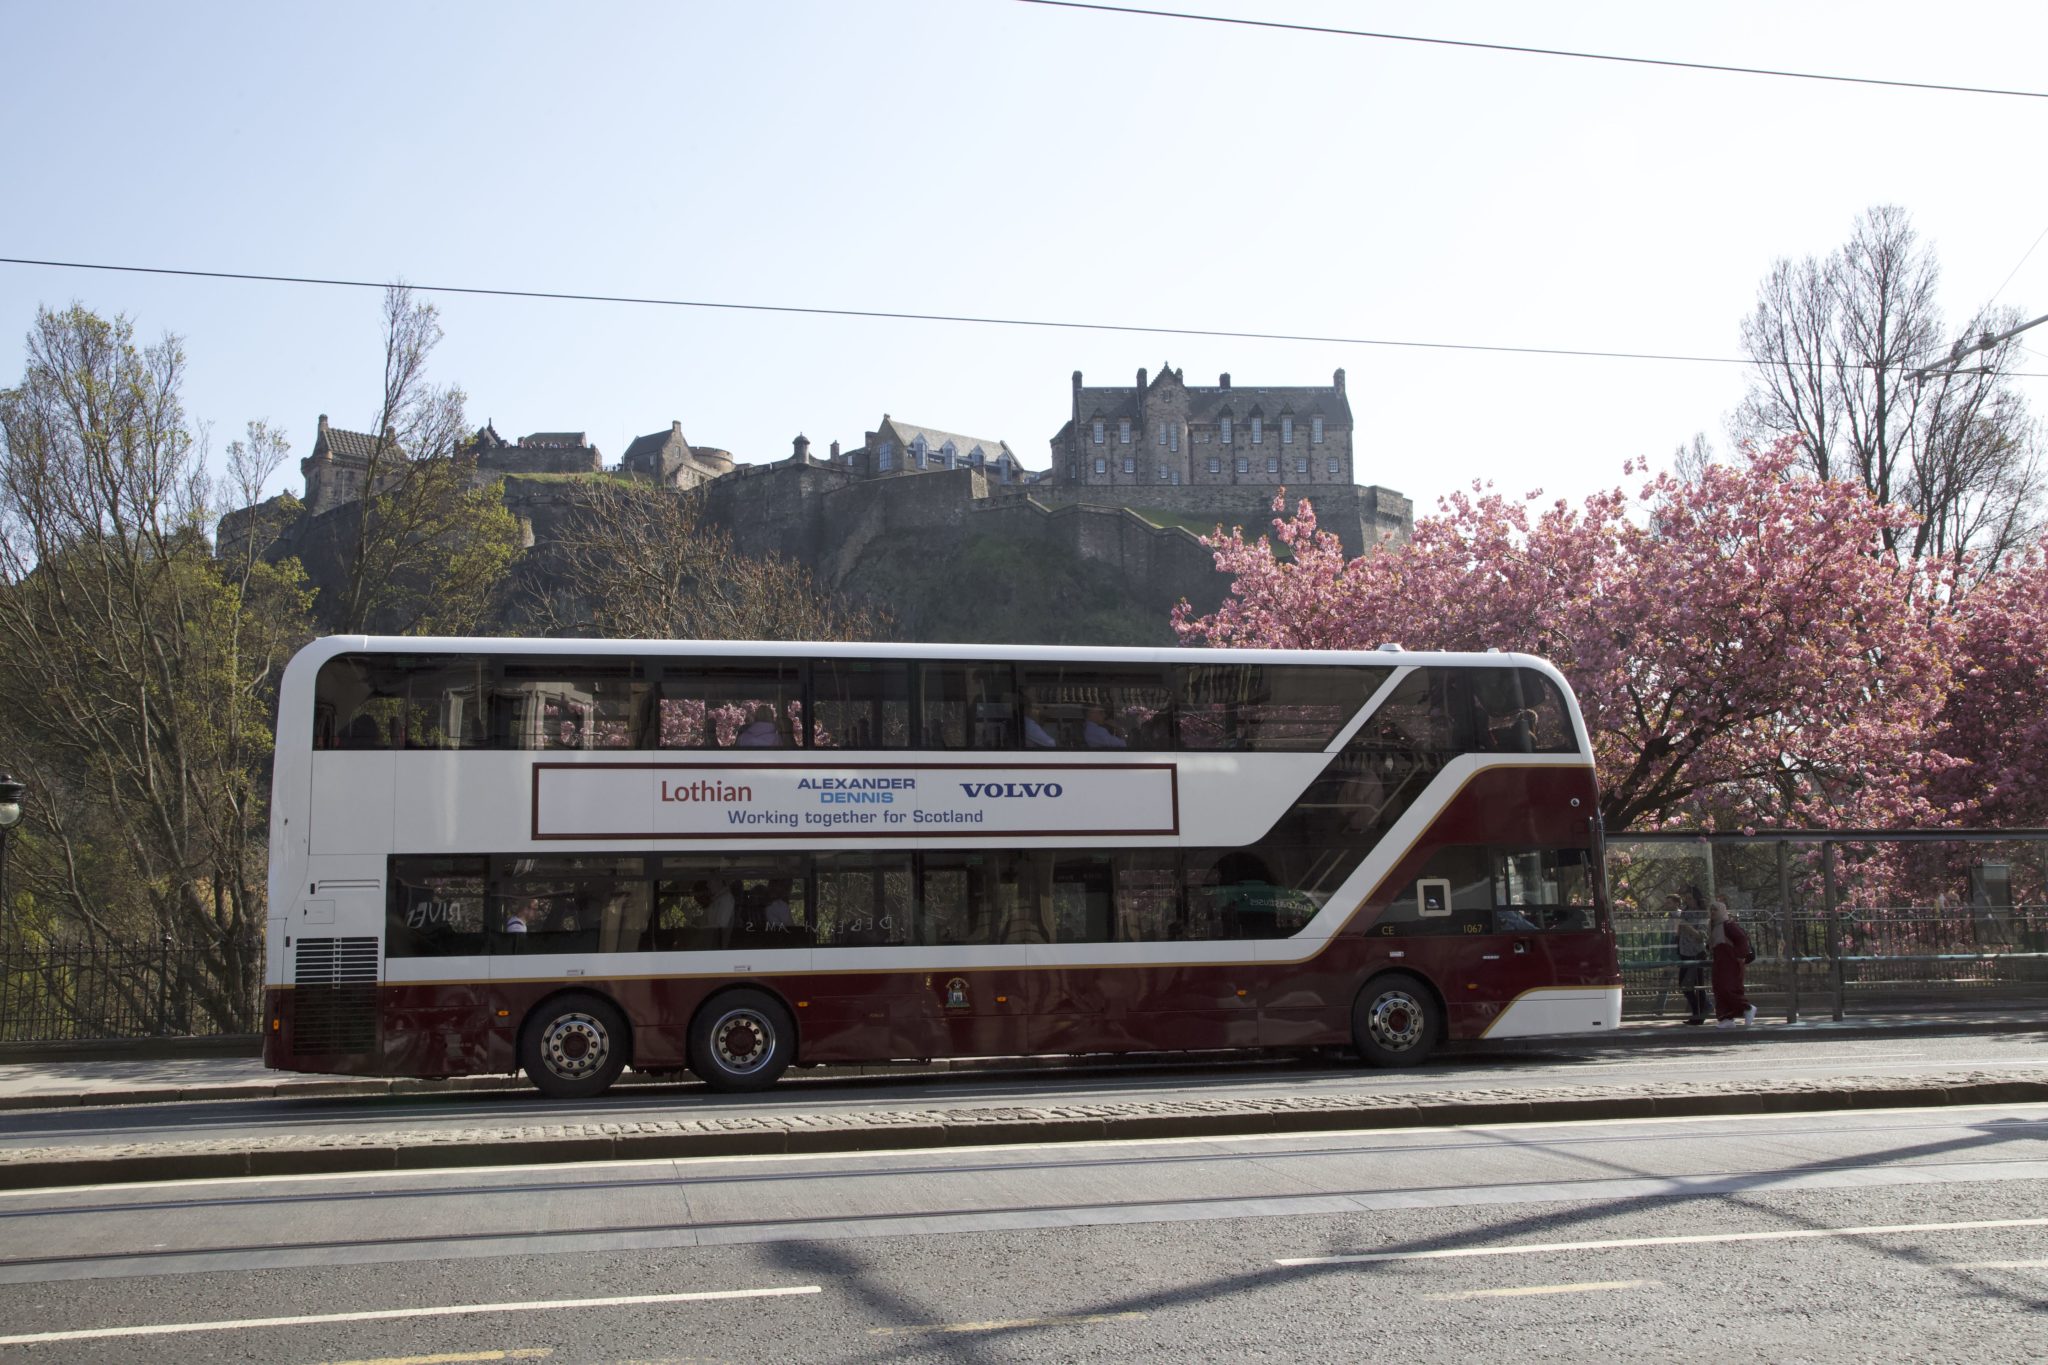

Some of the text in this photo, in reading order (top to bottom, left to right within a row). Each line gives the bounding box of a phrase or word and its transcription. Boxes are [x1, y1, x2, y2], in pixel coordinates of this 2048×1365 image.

[797, 778, 916, 790] ALEXANDER
[959, 782, 1064, 798] VOLVO
[661, 780, 752, 802] Lothian
[820, 792, 894, 804] DENNIS
[727, 809, 984, 827] Working together for Scotland
[1381, 926, 1395, 936] CE
[1462, 924, 1483, 934] 1067
